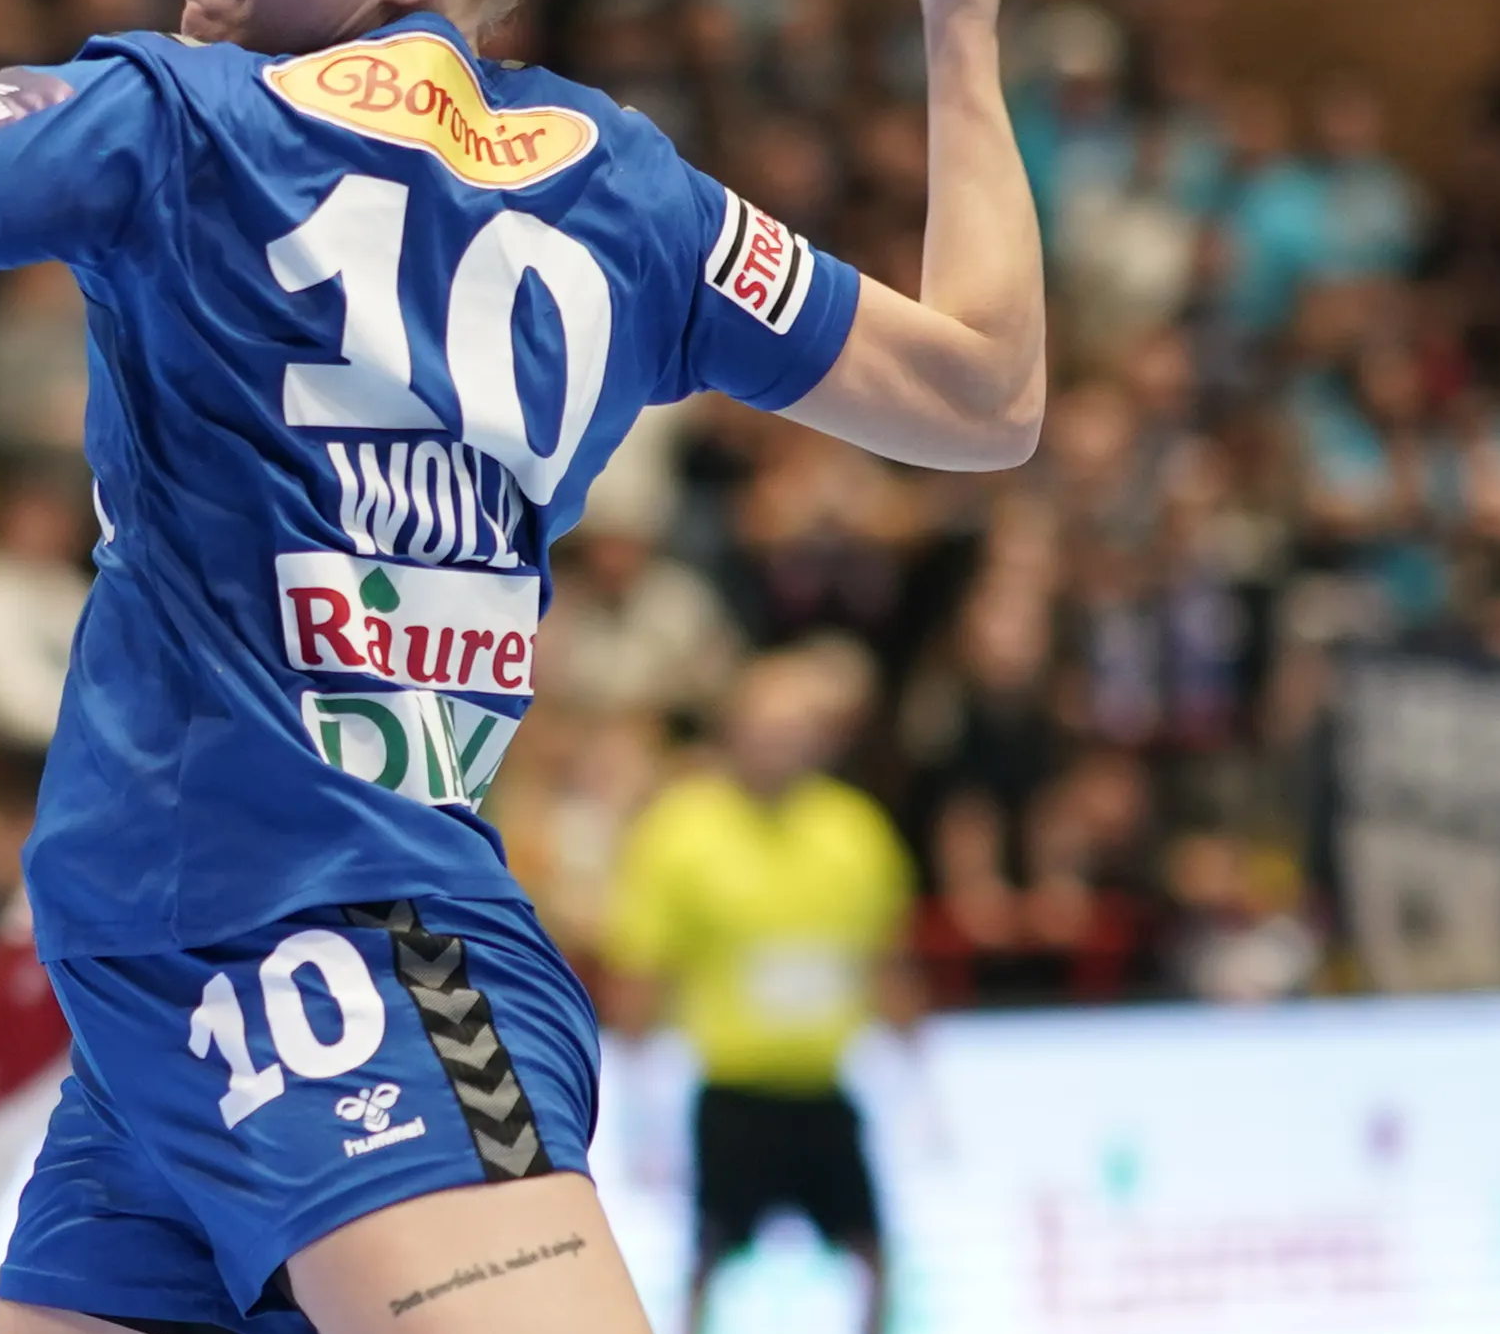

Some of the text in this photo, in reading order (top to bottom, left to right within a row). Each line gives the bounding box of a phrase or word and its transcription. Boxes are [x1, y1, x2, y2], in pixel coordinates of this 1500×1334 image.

[316, 54, 547, 167] Boromir
[733, 204, 785, 311] STRA
[265, 173, 612, 507] 10
[285, 567, 538, 690] Raure
[187, 928, 386, 1131] 10
[343, 1115, 426, 1158] hummel
